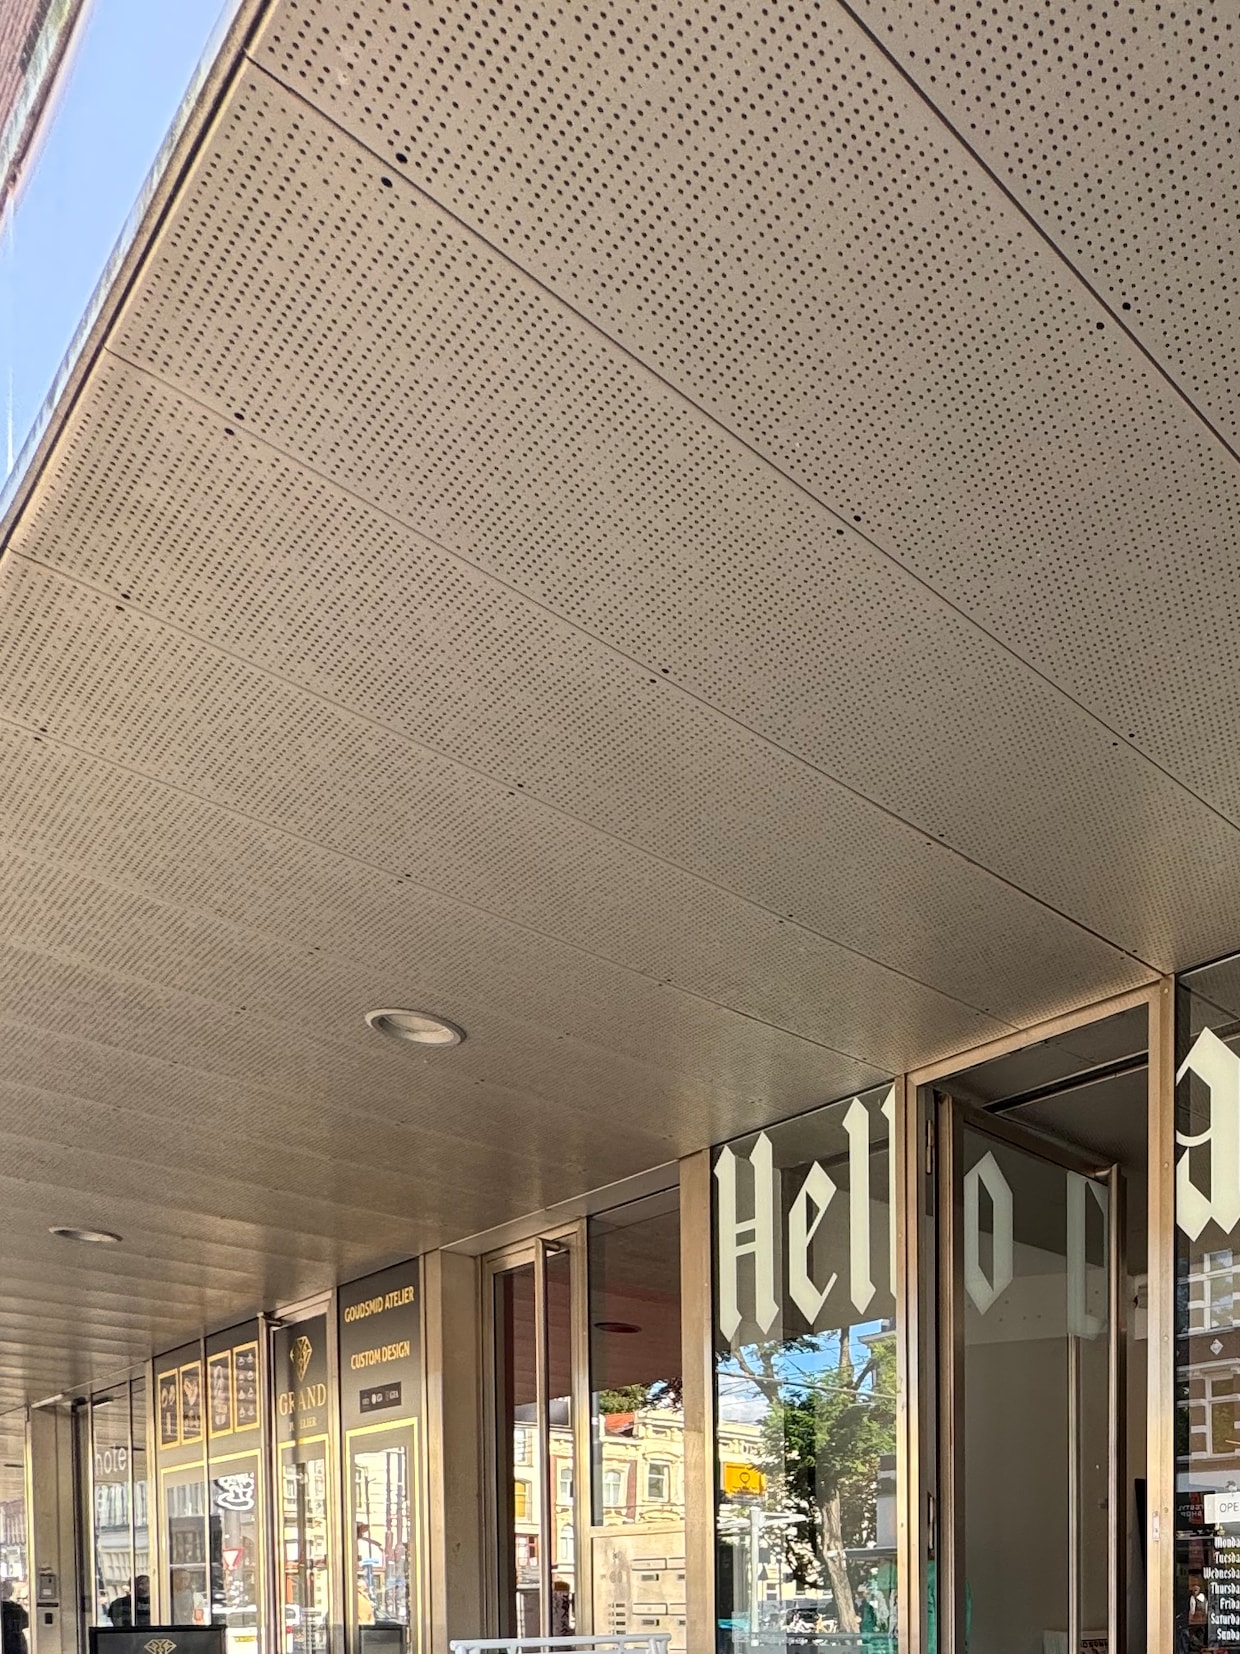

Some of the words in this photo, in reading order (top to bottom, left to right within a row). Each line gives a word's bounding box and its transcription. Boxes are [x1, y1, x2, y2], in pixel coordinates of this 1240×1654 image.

[344, 1296, 383, 1322] GOUDSMID
[384, 1286, 415, 1309] ATELIER
[350, 1348, 381, 1370] CUSTOM
[382, 1340, 410, 1362] DESIGN
